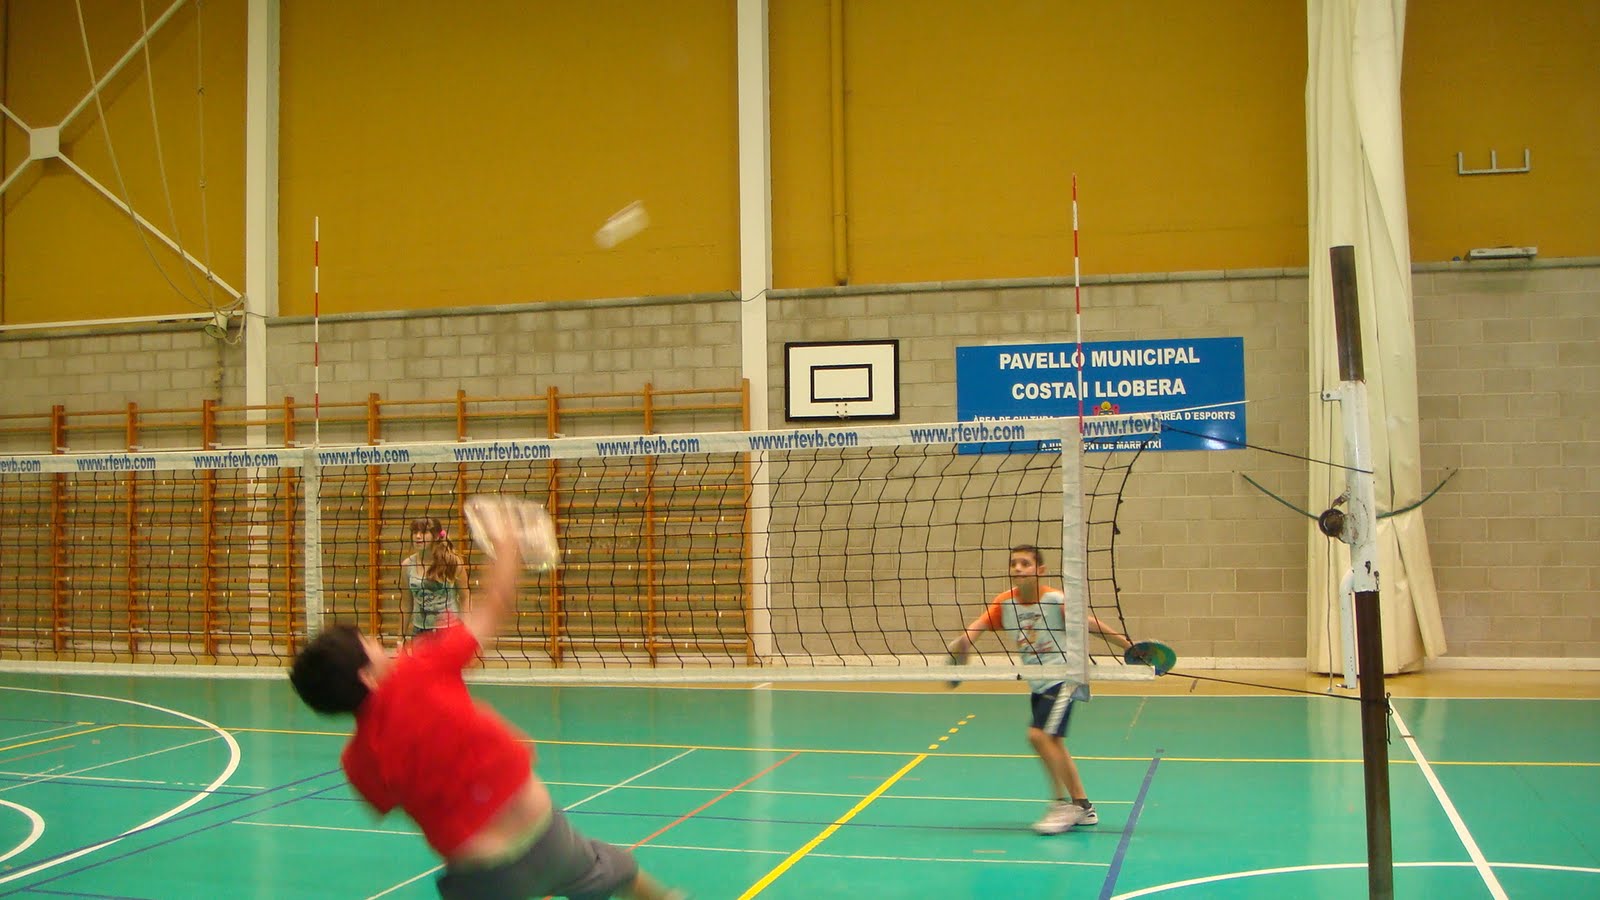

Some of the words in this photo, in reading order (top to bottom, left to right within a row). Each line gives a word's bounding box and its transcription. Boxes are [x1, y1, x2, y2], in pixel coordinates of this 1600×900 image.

[1000, 348, 1085, 370] PAVELLÓ
[1092, 347, 1200, 367] MUNICIPAL
[1012, 382, 1077, 400] COSTA
[1083, 381, 1089, 398] I
[1095, 378, 1186, 398] LLOBERA
[749, 430, 858, 450] www.rfevb.com
[910, 423, 1025, 443] www.rfevb.com
[318, 447, 409, 465] www.rfevb.com
[453, 442, 550, 461] www.rfevb.com
[596, 436, 700, 456] www.rfevb.com
[77, 455, 156, 471] www.rfevb.com
[193, 451, 278, 468] www.rfevb.com
